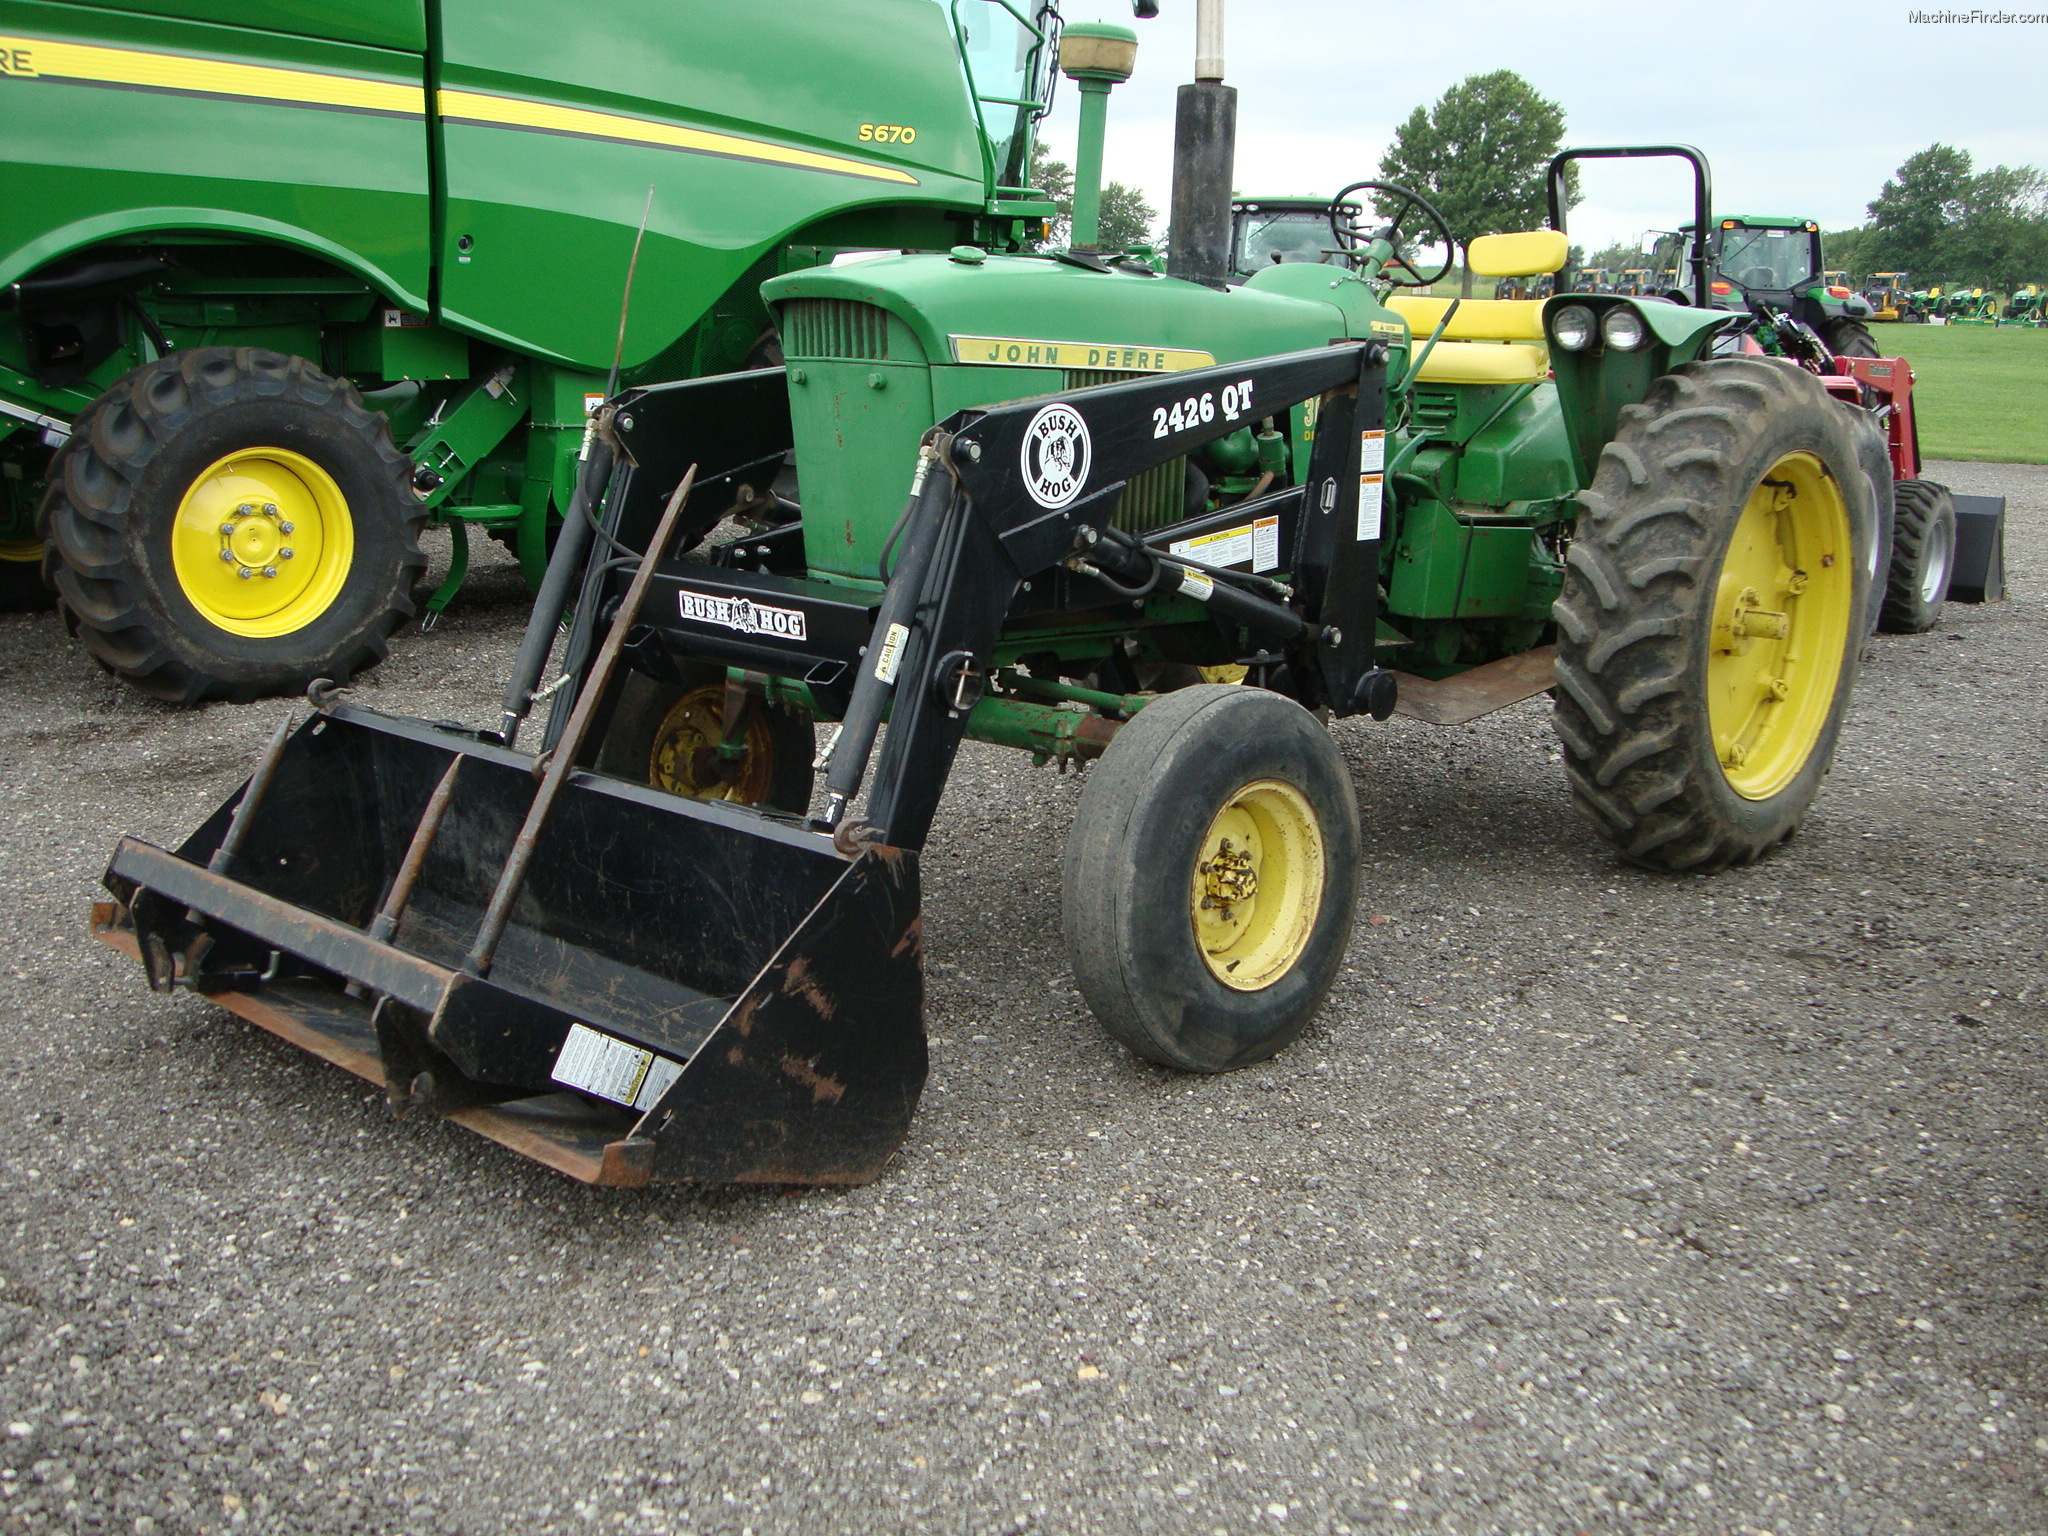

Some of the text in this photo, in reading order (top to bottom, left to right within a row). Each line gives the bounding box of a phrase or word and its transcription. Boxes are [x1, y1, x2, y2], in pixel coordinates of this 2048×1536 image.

[858, 123, 917, 145] S670
[988, 344, 1165, 369] JOHN DEERE
[1152, 379, 1254, 439] 2426 QT
[1038, 415, 1078, 439] BUSH
[1039, 477, 1071, 497] HOG
[683, 595, 801, 636] BUSH HOG
[882, 631, 898, 664] CAUION
